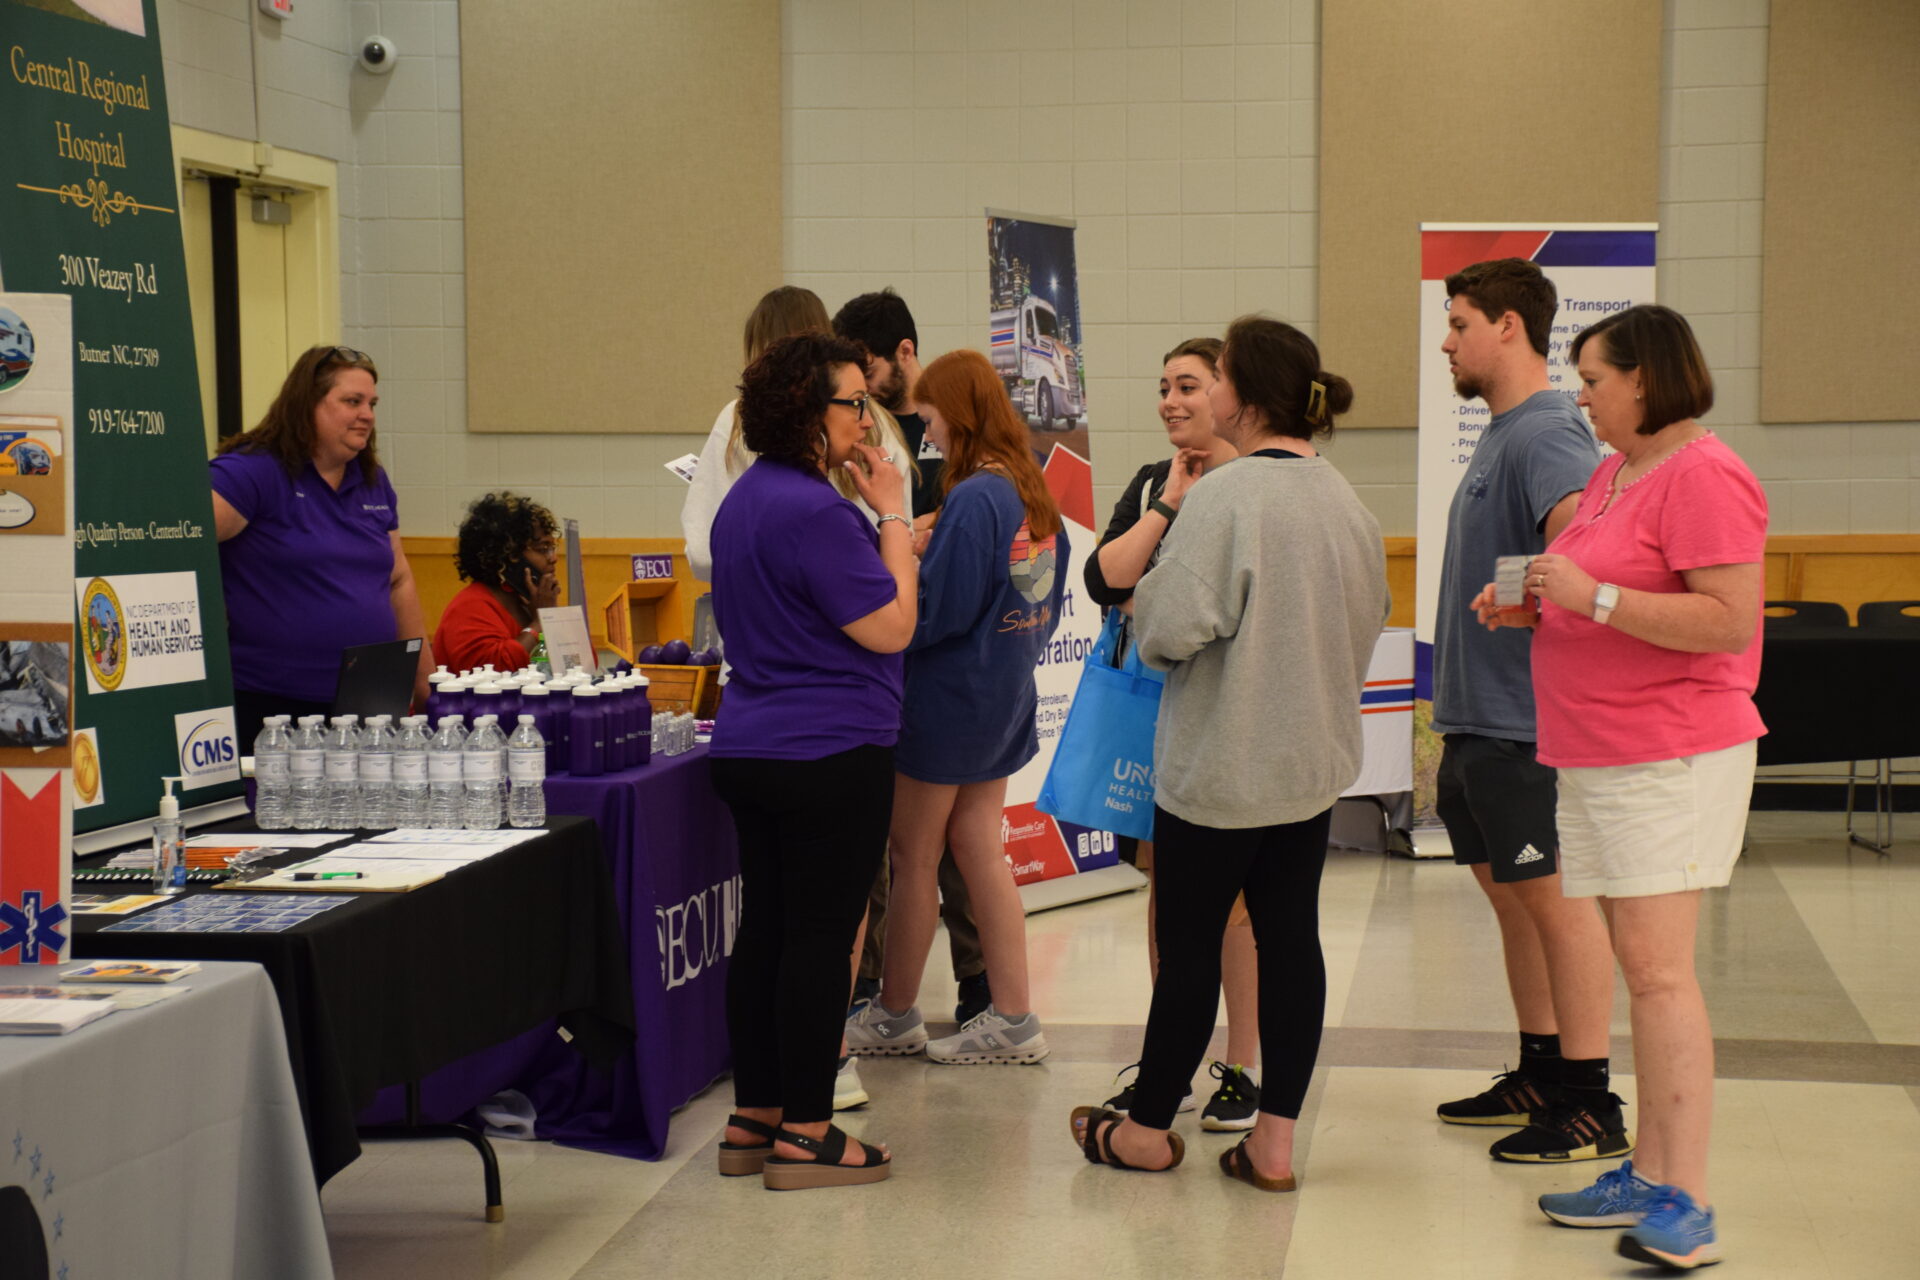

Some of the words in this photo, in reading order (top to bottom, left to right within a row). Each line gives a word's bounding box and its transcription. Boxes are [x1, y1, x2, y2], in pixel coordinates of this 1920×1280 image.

[10, 45, 77, 94] Central
[77, 61, 150, 116] Regional
[55, 121, 126, 177] Hospital
[59, 254, 85, 286] 300
[85, 257, 133, 303] Veazey
[134, 263, 158, 295] Rd
[1564, 298, 1632, 314] Transport
[78, 342, 110, 363] Butner
[88, 408, 165, 435] 919-764-7200
[1458, 421, 1487, 432] Bonu
[1458, 454, 1471, 464] Dr
[75, 522, 87, 549] gh
[87, 522, 117, 548] Quality
[183, 520, 203, 538] Care
[645, 560, 672, 577] ECU
[126, 605, 137, 618] NC
[138, 602, 184, 618] DEPARTMENT
[187, 600, 196, 614] OF
[1062, 588, 1075, 617] rt
[128, 619, 167, 640] HEALTH
[171, 618, 191, 636] AND
[131, 638, 163, 658] HUMAN
[164, 634, 204, 654] SERVICES
[1037, 631, 1093, 666] oration
[1045, 710, 1056, 724] Dry
[192, 736, 234, 767] CMS
[1109, 782, 1153, 802] HEALT
[1104, 796, 1133, 813] Nash
[1515, 853, 1544, 864] adidas
